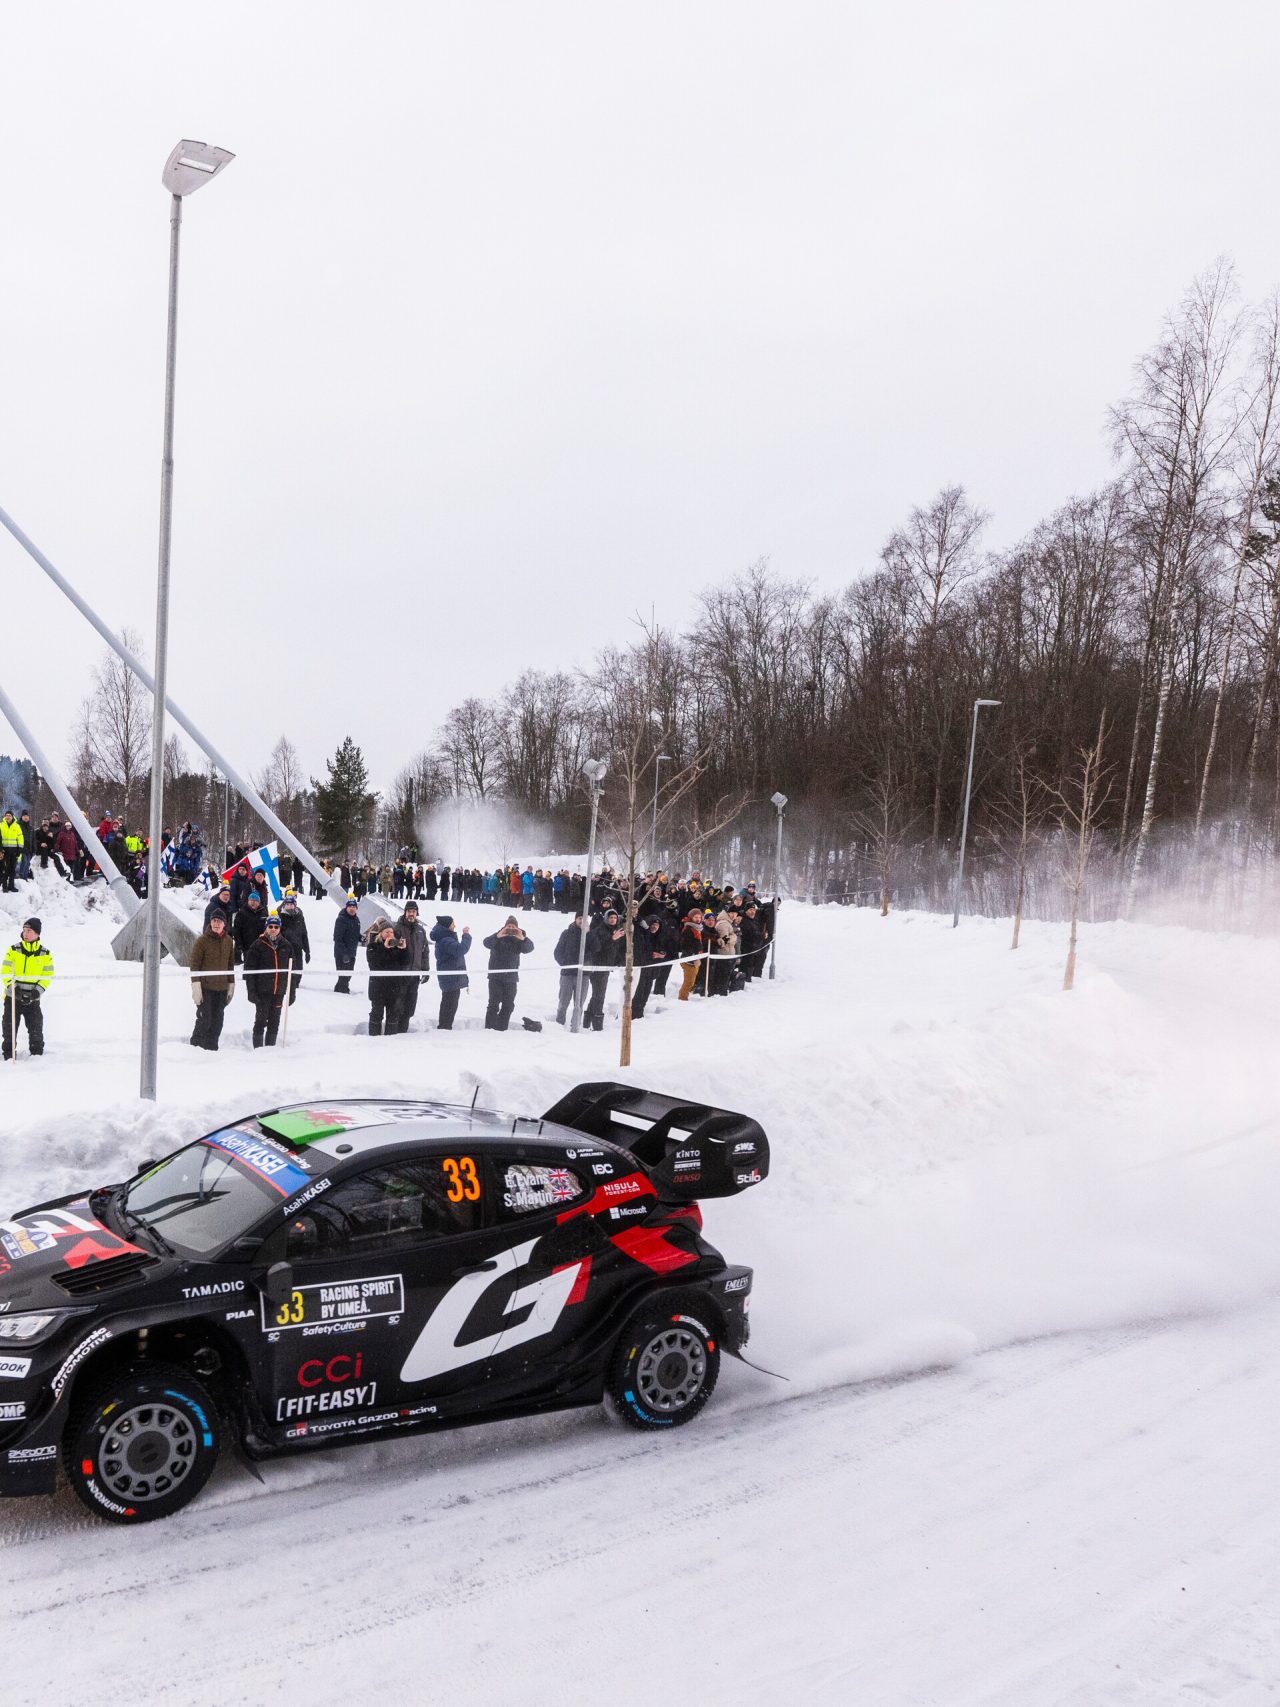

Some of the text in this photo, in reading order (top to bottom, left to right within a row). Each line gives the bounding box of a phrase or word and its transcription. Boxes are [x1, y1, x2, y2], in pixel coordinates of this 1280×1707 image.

[217, 1134, 288, 1175] AsahiKASEI
[442, 1157, 481, 1203] 33
[604, 1181, 639, 1192] NISULA
[737, 1168, 761, 1184] Stilo
[283, 1178, 332, 1216] AsahiKASEI
[620, 1205, 648, 1217] Microsoft
[182, 1280, 245, 1298] TAMADIC
[320, 1280, 395, 1303] RACING SPIRIT
[226, 1309, 255, 1321] PIAA
[276, 1291, 305, 1325] 33
[321, 1297, 371, 1319] BY UMEÅ.
[302, 1320, 367, 1337] SafetyCulture
[54, 1331, 113, 1398] AUTOMOTIVE
[286, 1405, 437, 1438] GR TOYOTA GAZOO Racing
